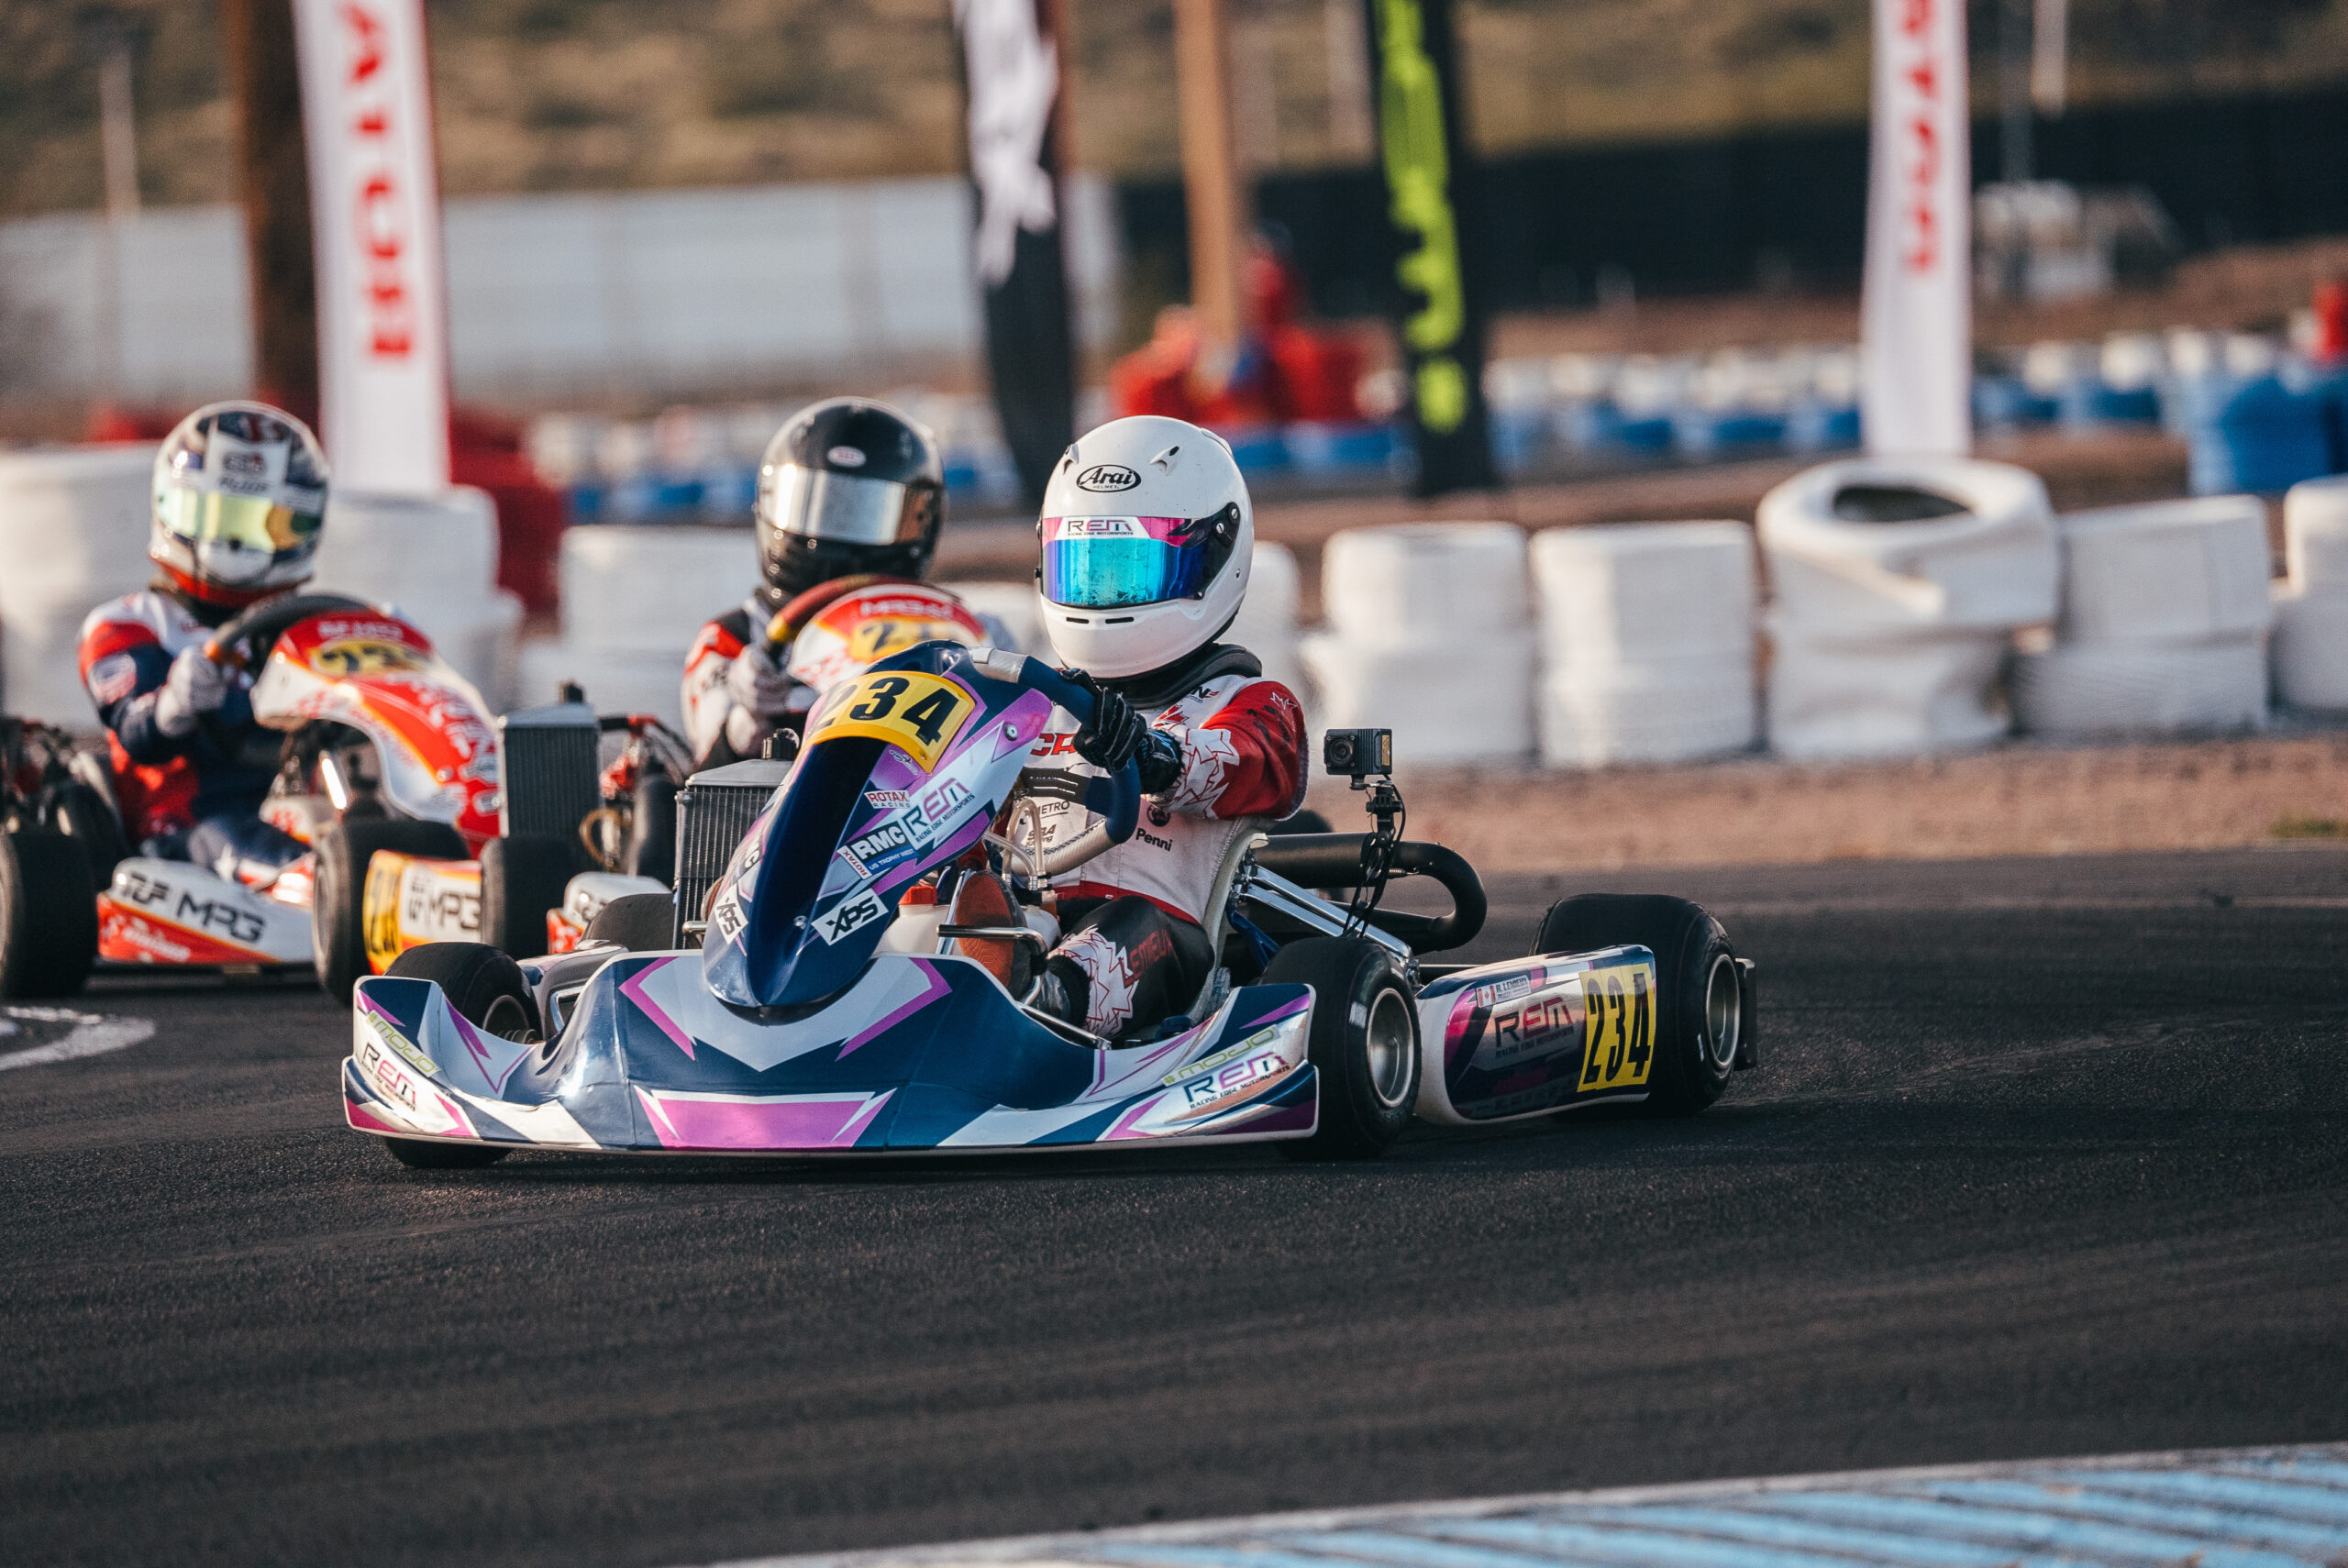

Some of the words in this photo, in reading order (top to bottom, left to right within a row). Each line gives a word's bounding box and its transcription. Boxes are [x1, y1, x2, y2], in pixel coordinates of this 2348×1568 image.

[1080, 468, 1133, 484] Arai
[1069, 519, 1132, 532] REM
[811, 677, 959, 746] 234
[868, 791, 910, 802] ROTAX
[902, 778, 969, 836] REM
[915, 828, 933, 843] RACING
[932, 820, 943, 831] EDGE
[944, 794, 976, 821] MOTORSPORTS
[1037, 801, 1069, 814] ETRO
[851, 826, 906, 860] RMC
[879, 854, 901, 865] TROPHY
[1135, 827, 1173, 852] Penni
[843, 850, 868, 876] ROTAX
[825, 895, 878, 942] XPS
[1495, 997, 1573, 1047] REM
[1583, 972, 1651, 1084] 234
[362, 1043, 415, 1105] REM
[1183, 1052, 1288, 1103] REM
[1190, 1095, 1218, 1110] RACING
[1220, 1088, 1237, 1099] EDGE
[1240, 1066, 1290, 1089] MOTORSPORTS
